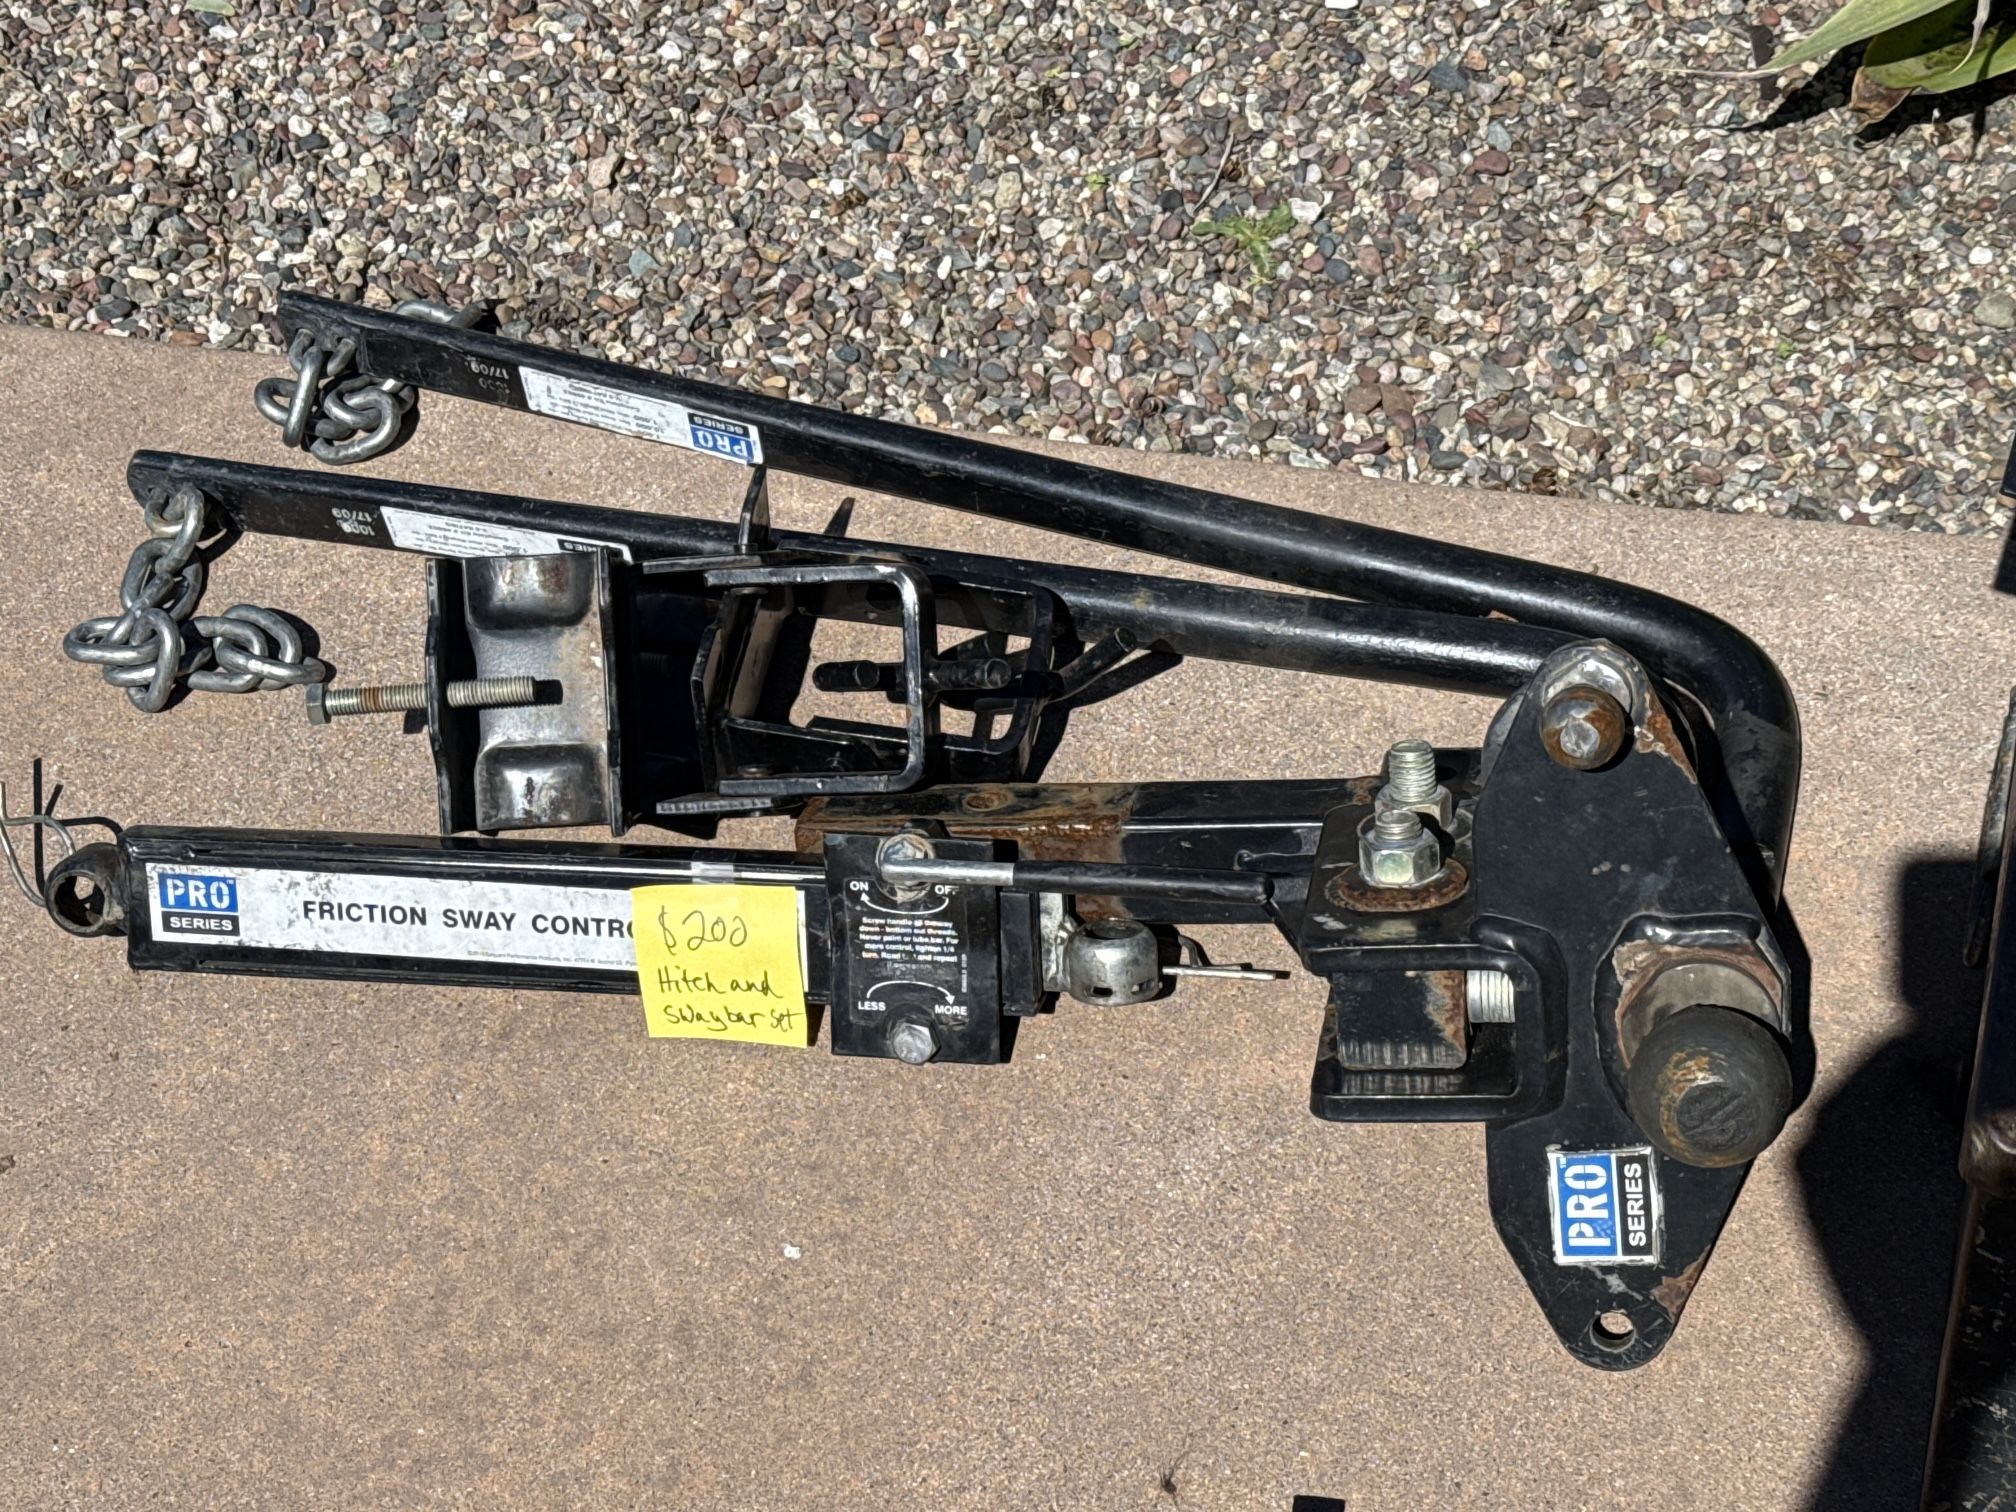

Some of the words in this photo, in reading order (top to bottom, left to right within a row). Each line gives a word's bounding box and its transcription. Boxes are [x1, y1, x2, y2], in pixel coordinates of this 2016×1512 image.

[693, 415, 744, 435] SERIES
[694, 429, 748, 459] PRO
[331, 508, 372, 522] 17/09
[563, 541, 597, 553] RIES
[166, 877, 230, 909] PRO
[849, 881, 869, 891] ON
[169, 916, 233, 931] SERIES
[303, 900, 427, 926] FRICTION
[442, 908, 516, 931] SWAY
[862, 916, 885, 925] Screw
[886, 918, 912, 926] handle
[658, 905, 748, 956] $200
[933, 955, 958, 963] repeat
[657, 965, 727, 994] Hitch
[730, 970, 784, 999] and
[858, 1000, 886, 1011] LESS
[935, 1005, 968, 1016] MORE
[1563, 1164, 1612, 1247] PRO
[1623, 1162, 1647, 1247] SERIES
